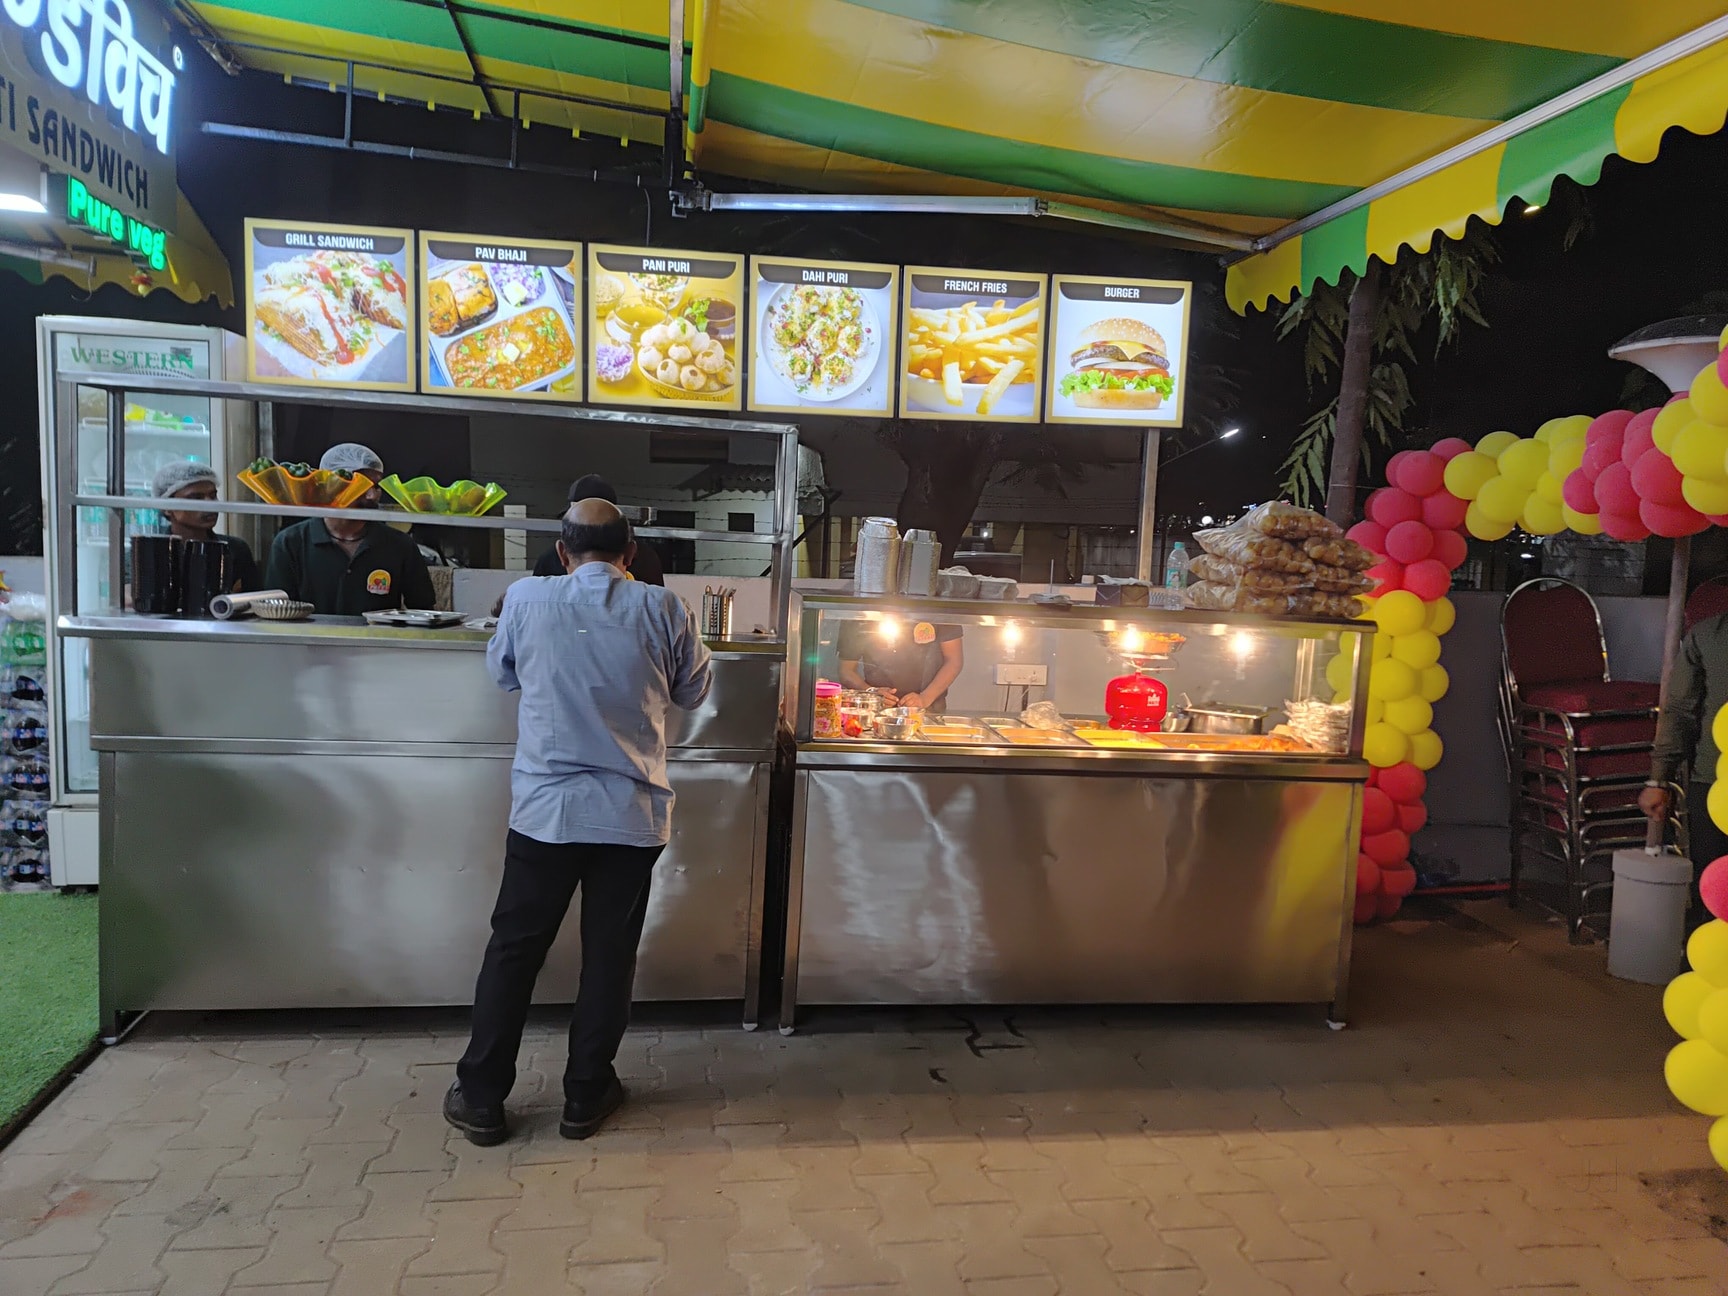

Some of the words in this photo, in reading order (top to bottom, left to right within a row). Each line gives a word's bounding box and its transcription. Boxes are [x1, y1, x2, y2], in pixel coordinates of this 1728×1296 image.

[27, 95, 148, 210] SANDWICH
[68, 176, 125, 241] Pure
[128, 217, 167, 271] veg
[285, 232, 316, 247] GRILL
[317, 234, 374, 250] SANDWICH
[475, 246, 496, 260] PAV
[497, 247, 528, 262] BHAJI
[642, 258, 666, 272] PANI
[667, 259, 690, 273] PURI
[802, 270, 825, 283] DAHI
[826, 271, 849, 284] PURI
[944, 280, 980, 293] FRENCH
[981, 281, 1008, 294] FRIES
[1104, 287, 1140, 299] BURGER
[71, 346, 194, 370] WESTERN
